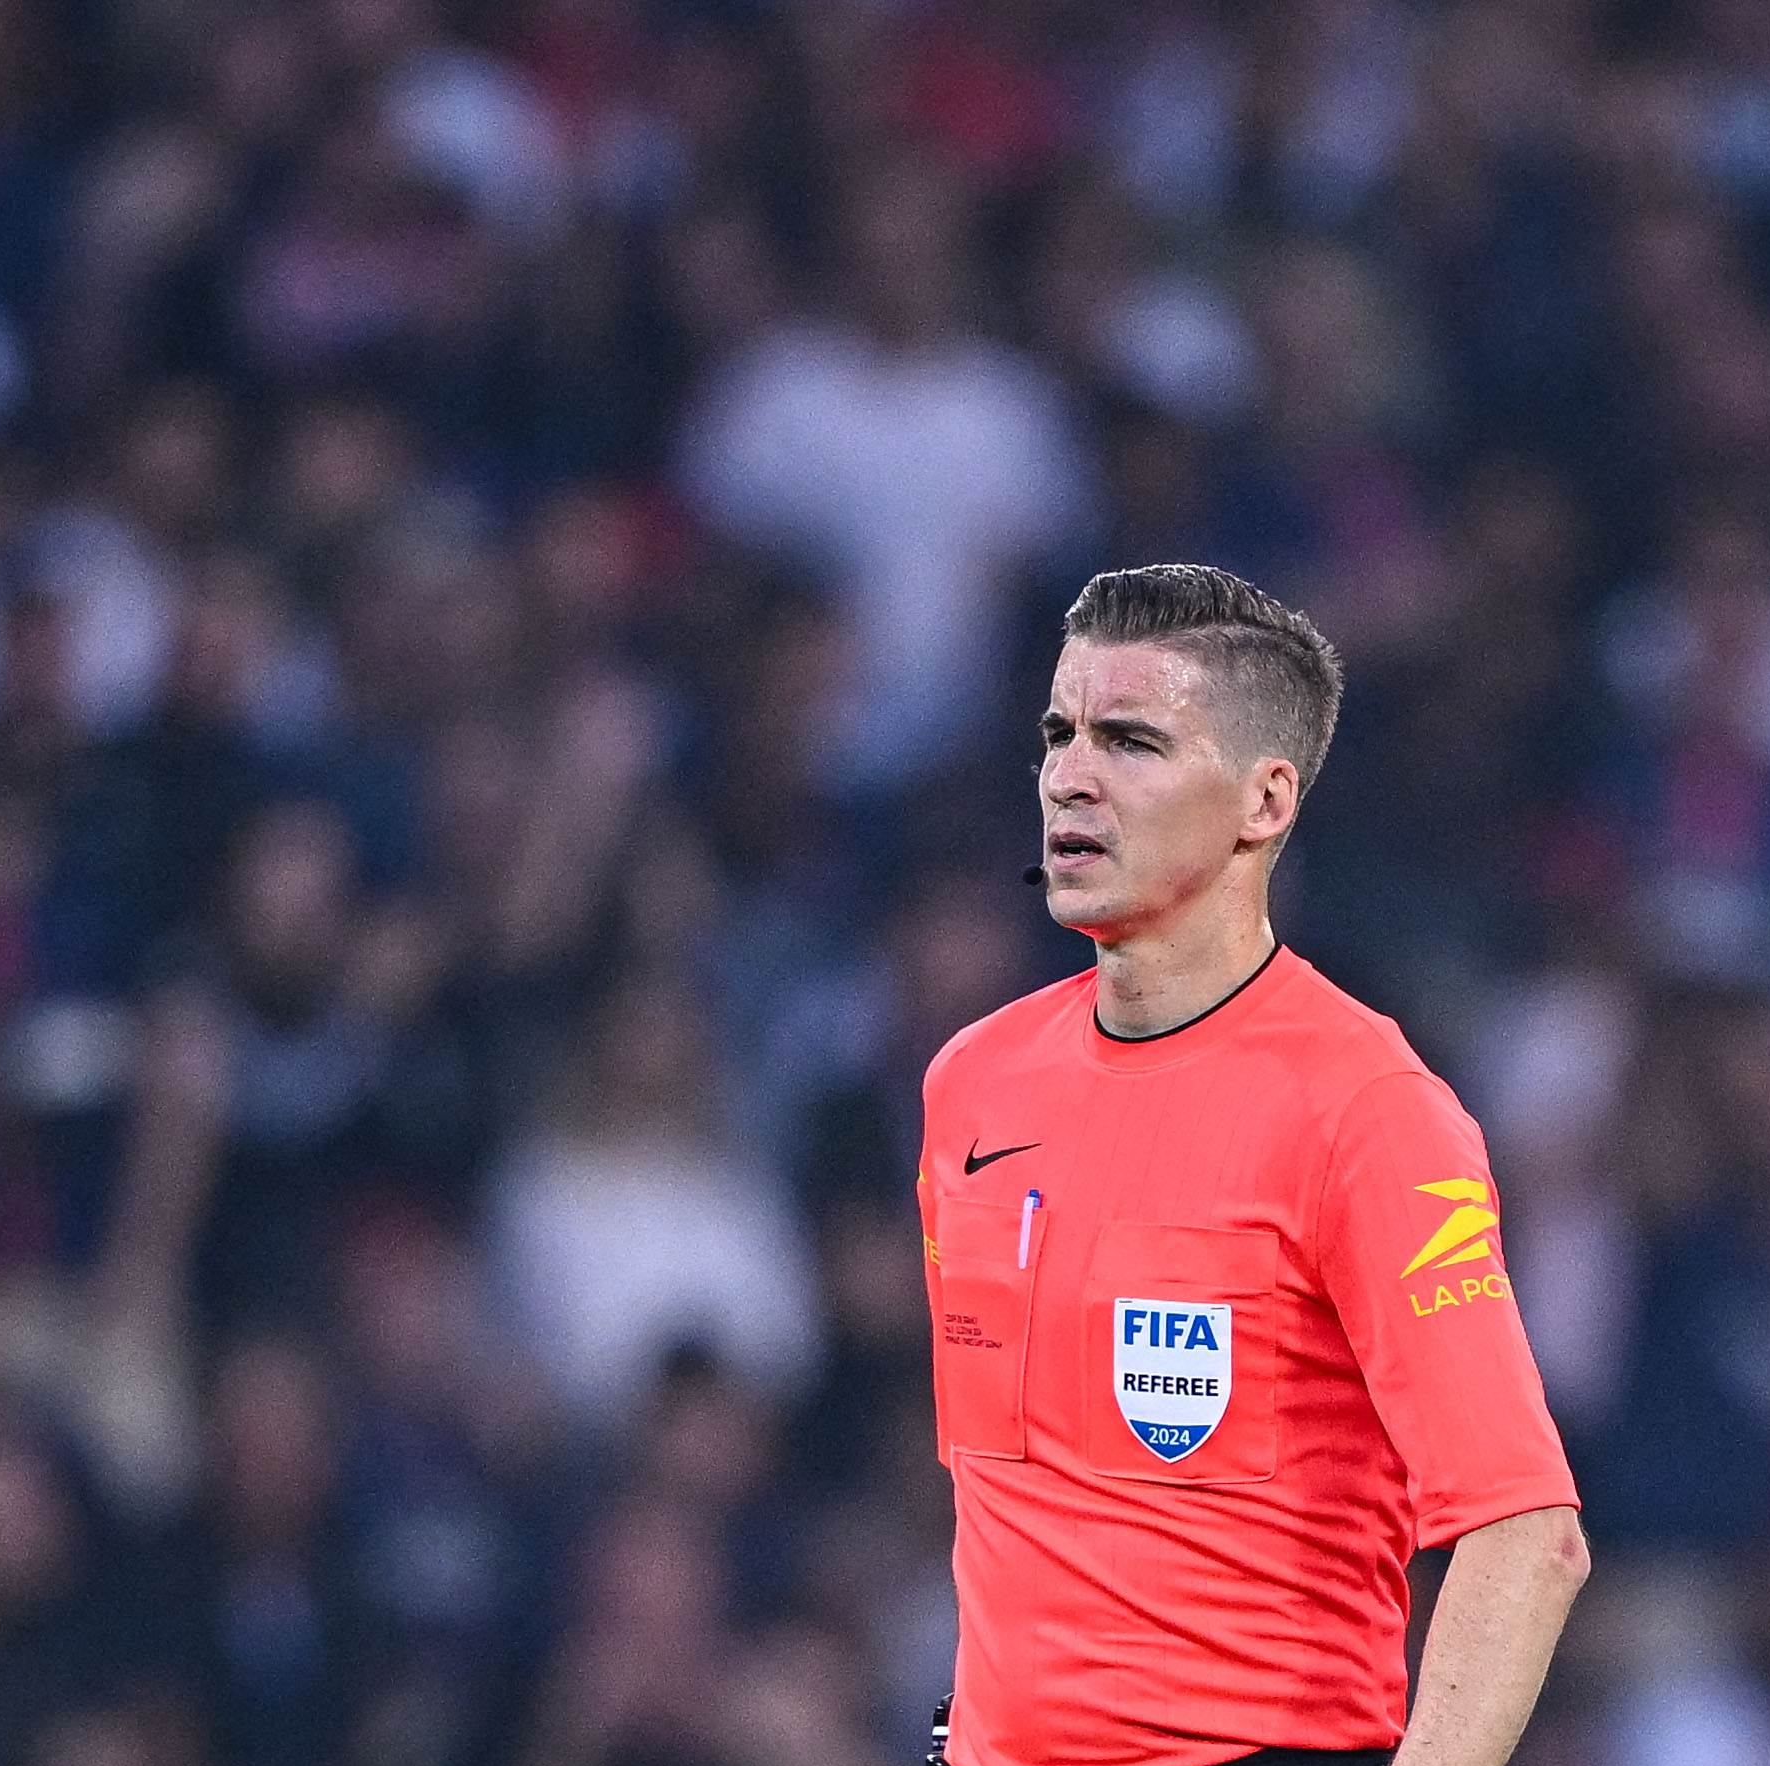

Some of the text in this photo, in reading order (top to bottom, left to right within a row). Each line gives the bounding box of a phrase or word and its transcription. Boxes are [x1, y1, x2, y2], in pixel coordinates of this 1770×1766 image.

[1410, 1285, 1460, 1317] LA
[1124, 1310, 1219, 1351] FIFA
[1124, 1373, 1219, 1396] REFEREE
[1148, 1427, 1191, 1446] 2024
